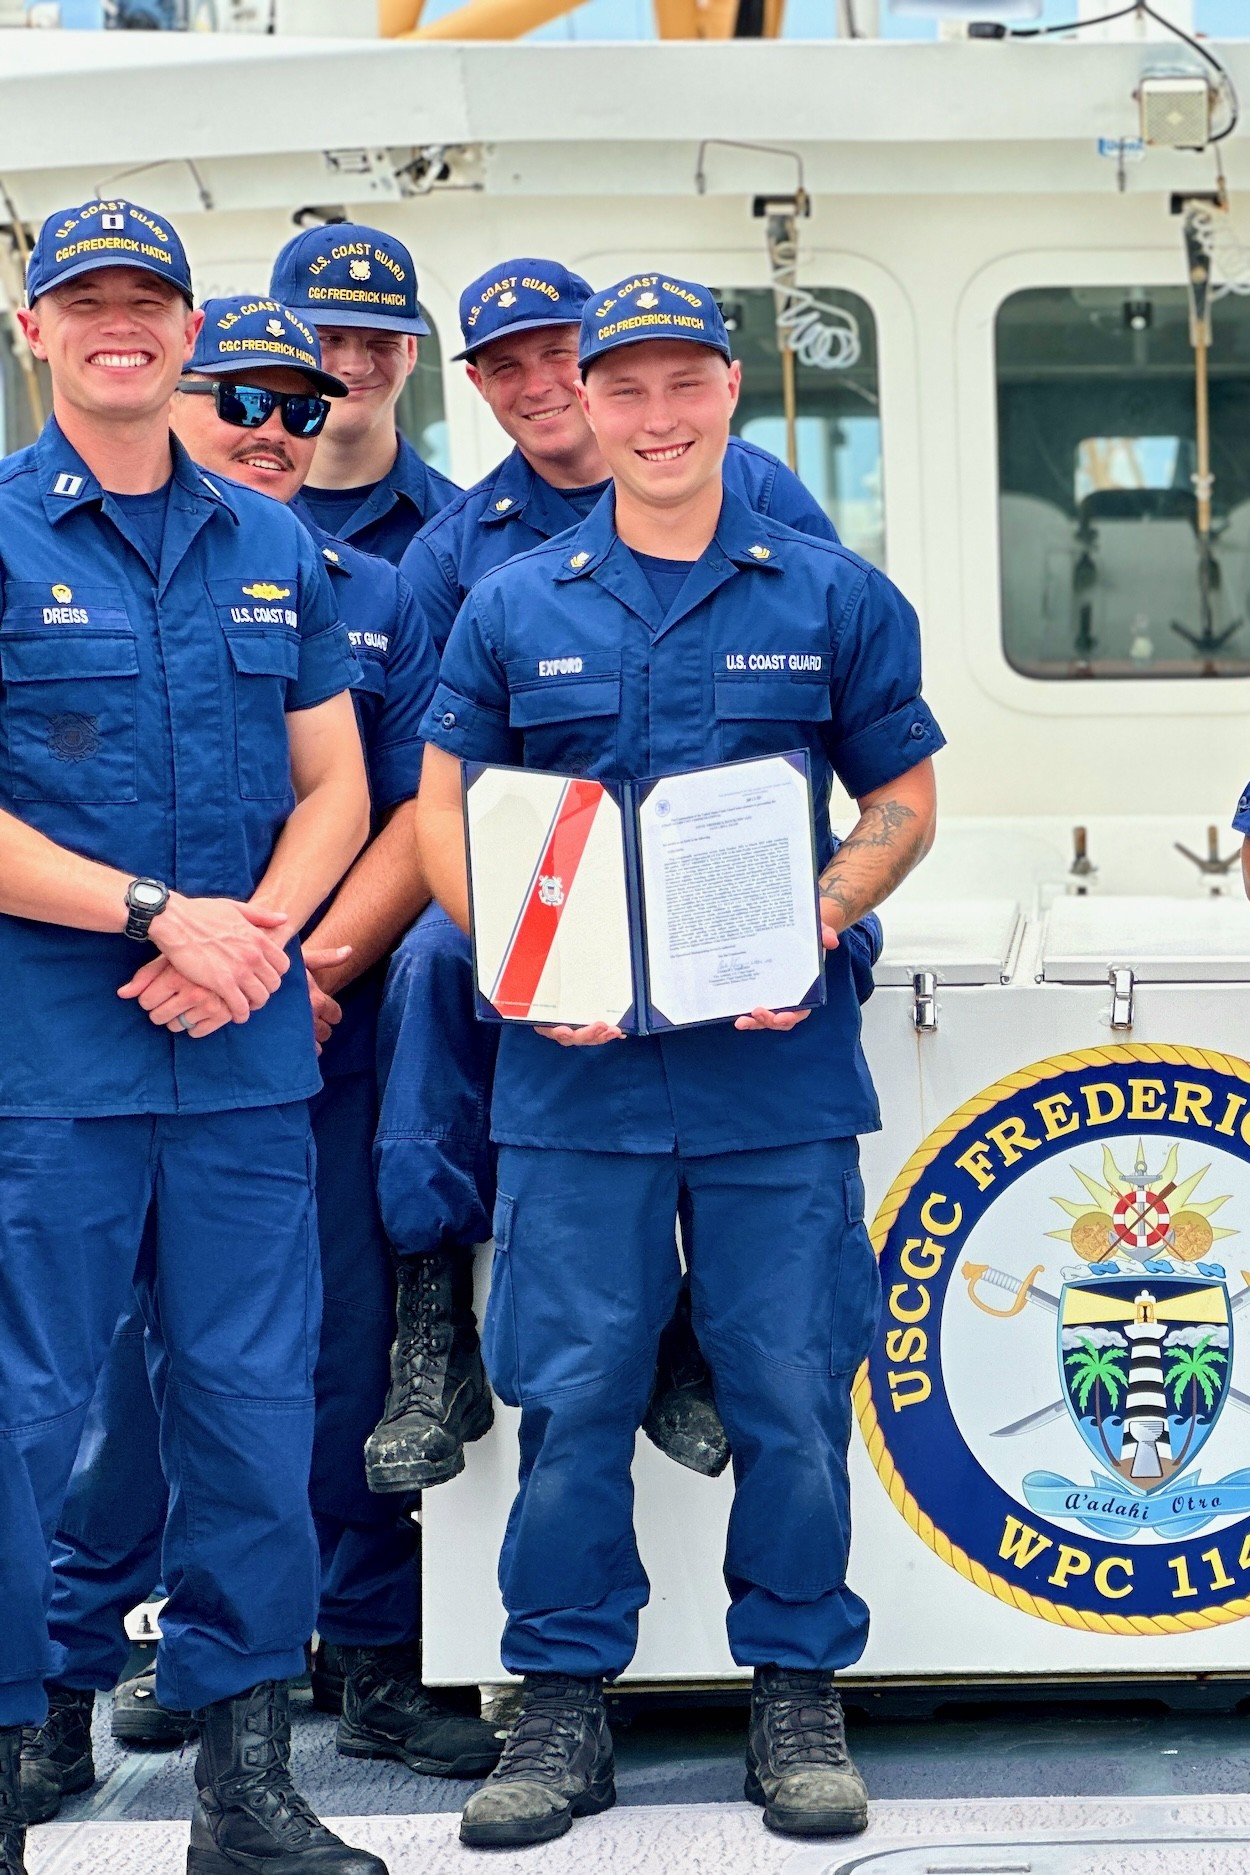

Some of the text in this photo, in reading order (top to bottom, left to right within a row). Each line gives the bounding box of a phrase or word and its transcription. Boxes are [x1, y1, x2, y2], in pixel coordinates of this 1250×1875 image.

[56, 202, 169, 242] U.S. COAST GUARD
[56, 238, 172, 264] CGC FREDERICK HATCH
[309, 243, 405, 282] U.S. COAST GUARD
[308, 287, 406, 306] CGC FREDERICK HATCH
[468, 276, 560, 326] U.S. COAST GUARD
[595, 277, 703, 318] U.S. COAST GUARD
[217, 301, 314, 345] U.S. COAST GUARD
[598, 314, 705, 340] CGC FREDERICK HATCH
[219, 340, 317, 368] CGC FREDERICK HATCH
[42, 607, 89, 624] DREISS
[231, 608, 253, 623] U.S.
[254, 608, 283, 623] COAST
[539, 657, 583, 677] EXFORD
[726, 654, 821, 671] U.S. COAST GUARD
[885, 1192, 963, 1413] USCGC
[1172, 1496, 1222, 1513] Otro
[997, 1514, 1134, 1600] WPC
